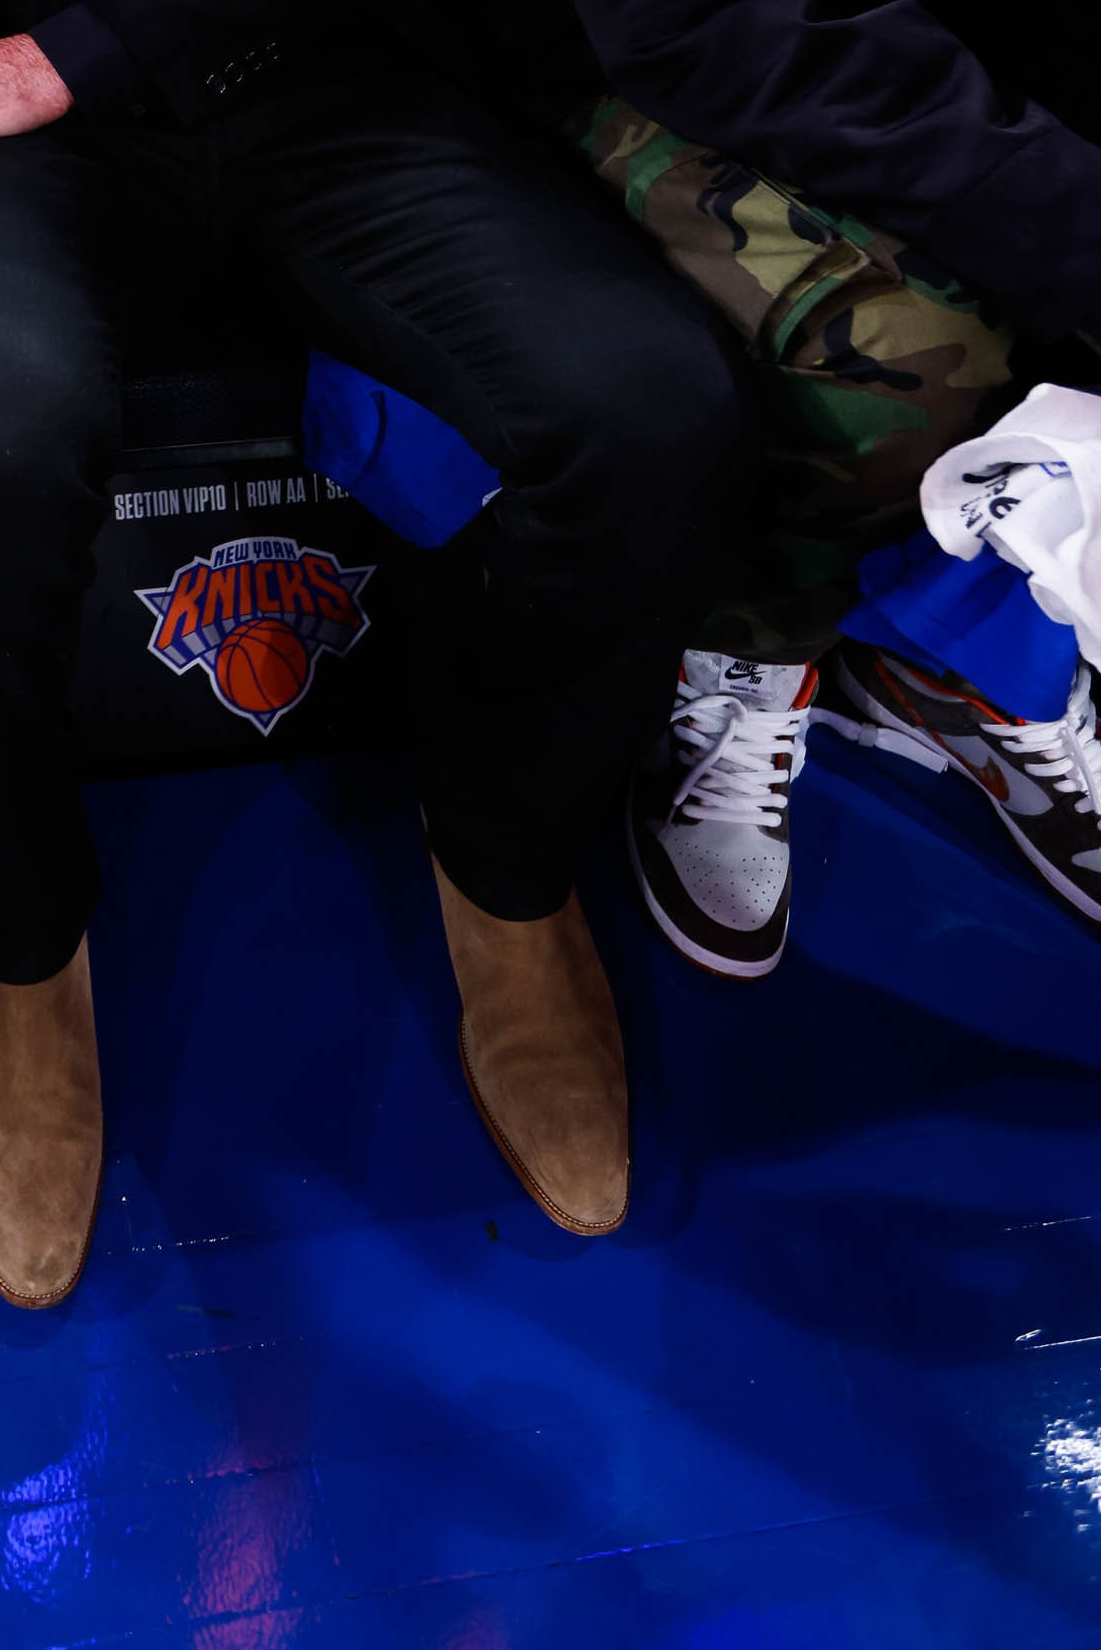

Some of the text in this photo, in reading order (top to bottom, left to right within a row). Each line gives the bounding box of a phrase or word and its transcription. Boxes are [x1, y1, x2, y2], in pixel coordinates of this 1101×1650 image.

[113, 489, 181, 521] SECTION
[181, 483, 227, 515] VIP10
[245, 478, 282, 508] ROW
[286, 477, 307, 504] AA
[213, 540, 297, 569] NEW YORK
[155, 554, 363, 651] KNICKS
[731, 661, 760, 674] NIKE
[748, 675, 763, 685] SB
